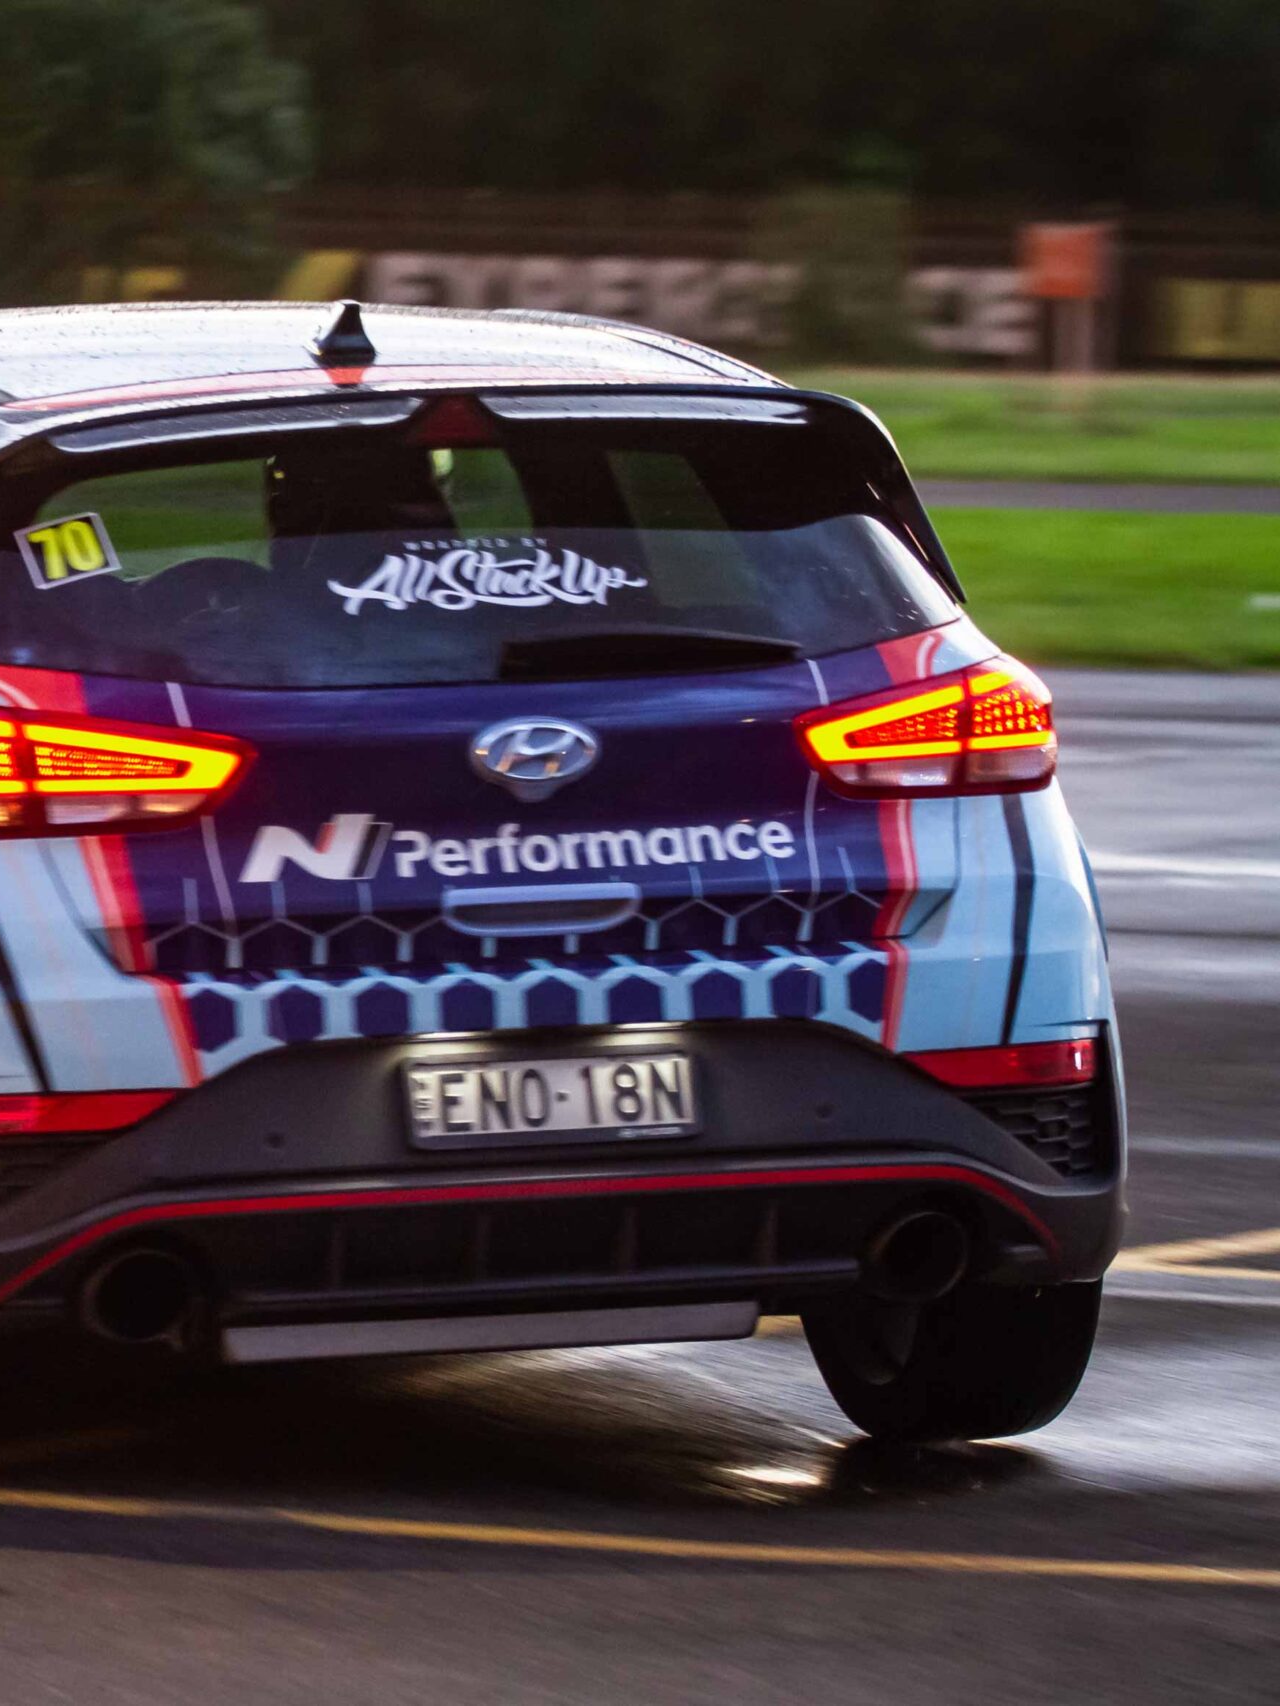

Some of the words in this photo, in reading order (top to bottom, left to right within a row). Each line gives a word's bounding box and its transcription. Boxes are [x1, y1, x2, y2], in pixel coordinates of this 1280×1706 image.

[27, 520, 105, 580] 70
[240, 813, 386, 883] N
[392, 820, 797, 879] Performance
